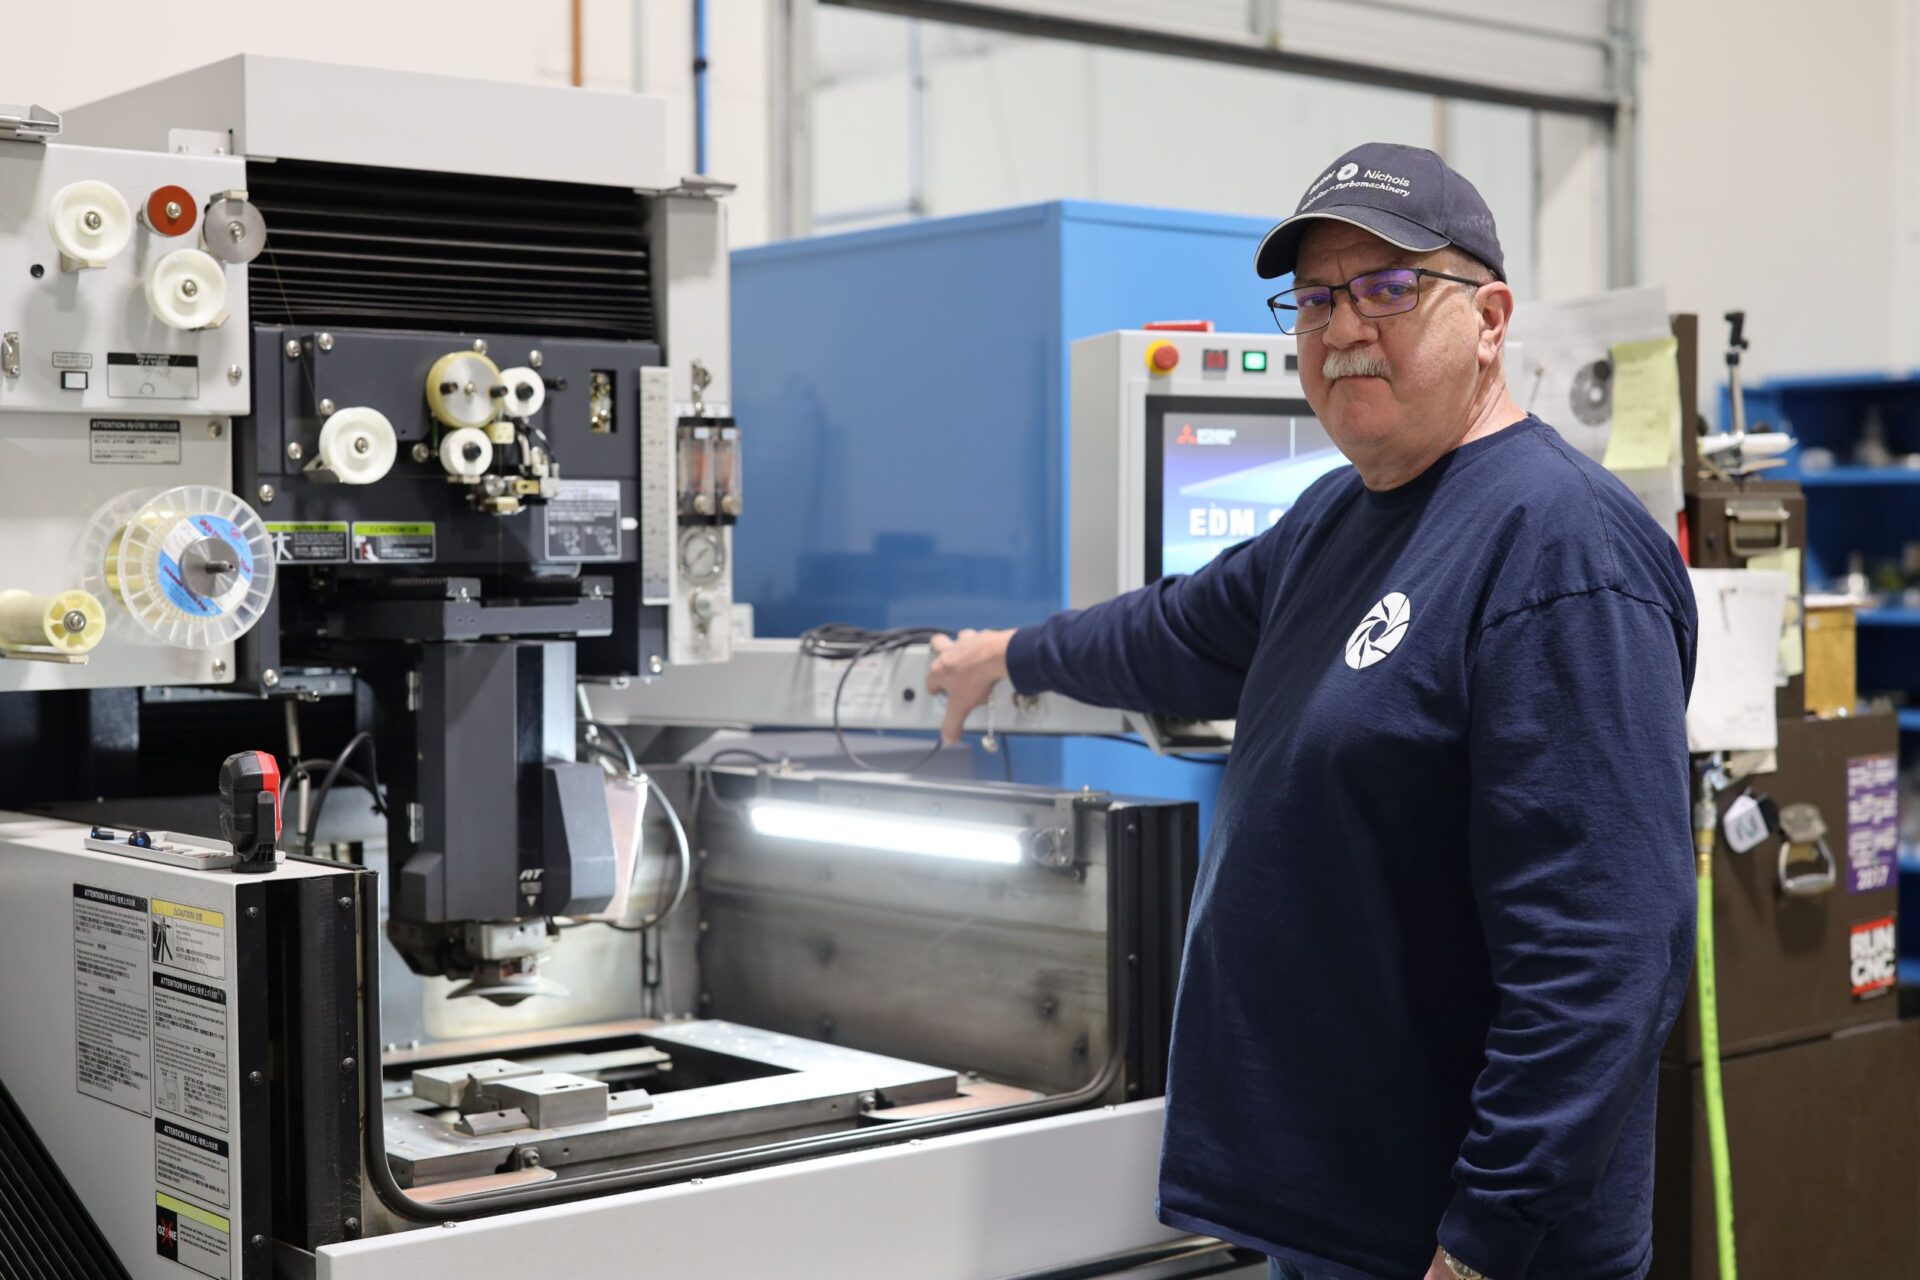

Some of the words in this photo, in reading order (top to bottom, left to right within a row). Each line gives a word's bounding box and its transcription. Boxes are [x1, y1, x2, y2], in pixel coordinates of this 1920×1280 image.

[1364, 169, 1410, 187] Nichols
[1335, 180, 1410, 198] Turbomachinery
[1189, 508, 1255, 537] EDM
[1856, 865, 1890, 890] 2017
[84, 889, 104, 900] ATTENTION
[1850, 924, 1895, 958] RUN
[1850, 951, 1895, 986] CNC
[161, 977, 182, 990] ATTENTION
[188, 984, 196, 994] USE
[164, 1125, 185, 1139] ATTENTION
[190, 1134, 198, 1144] USE
[157, 1224, 178, 1241] OZNE
